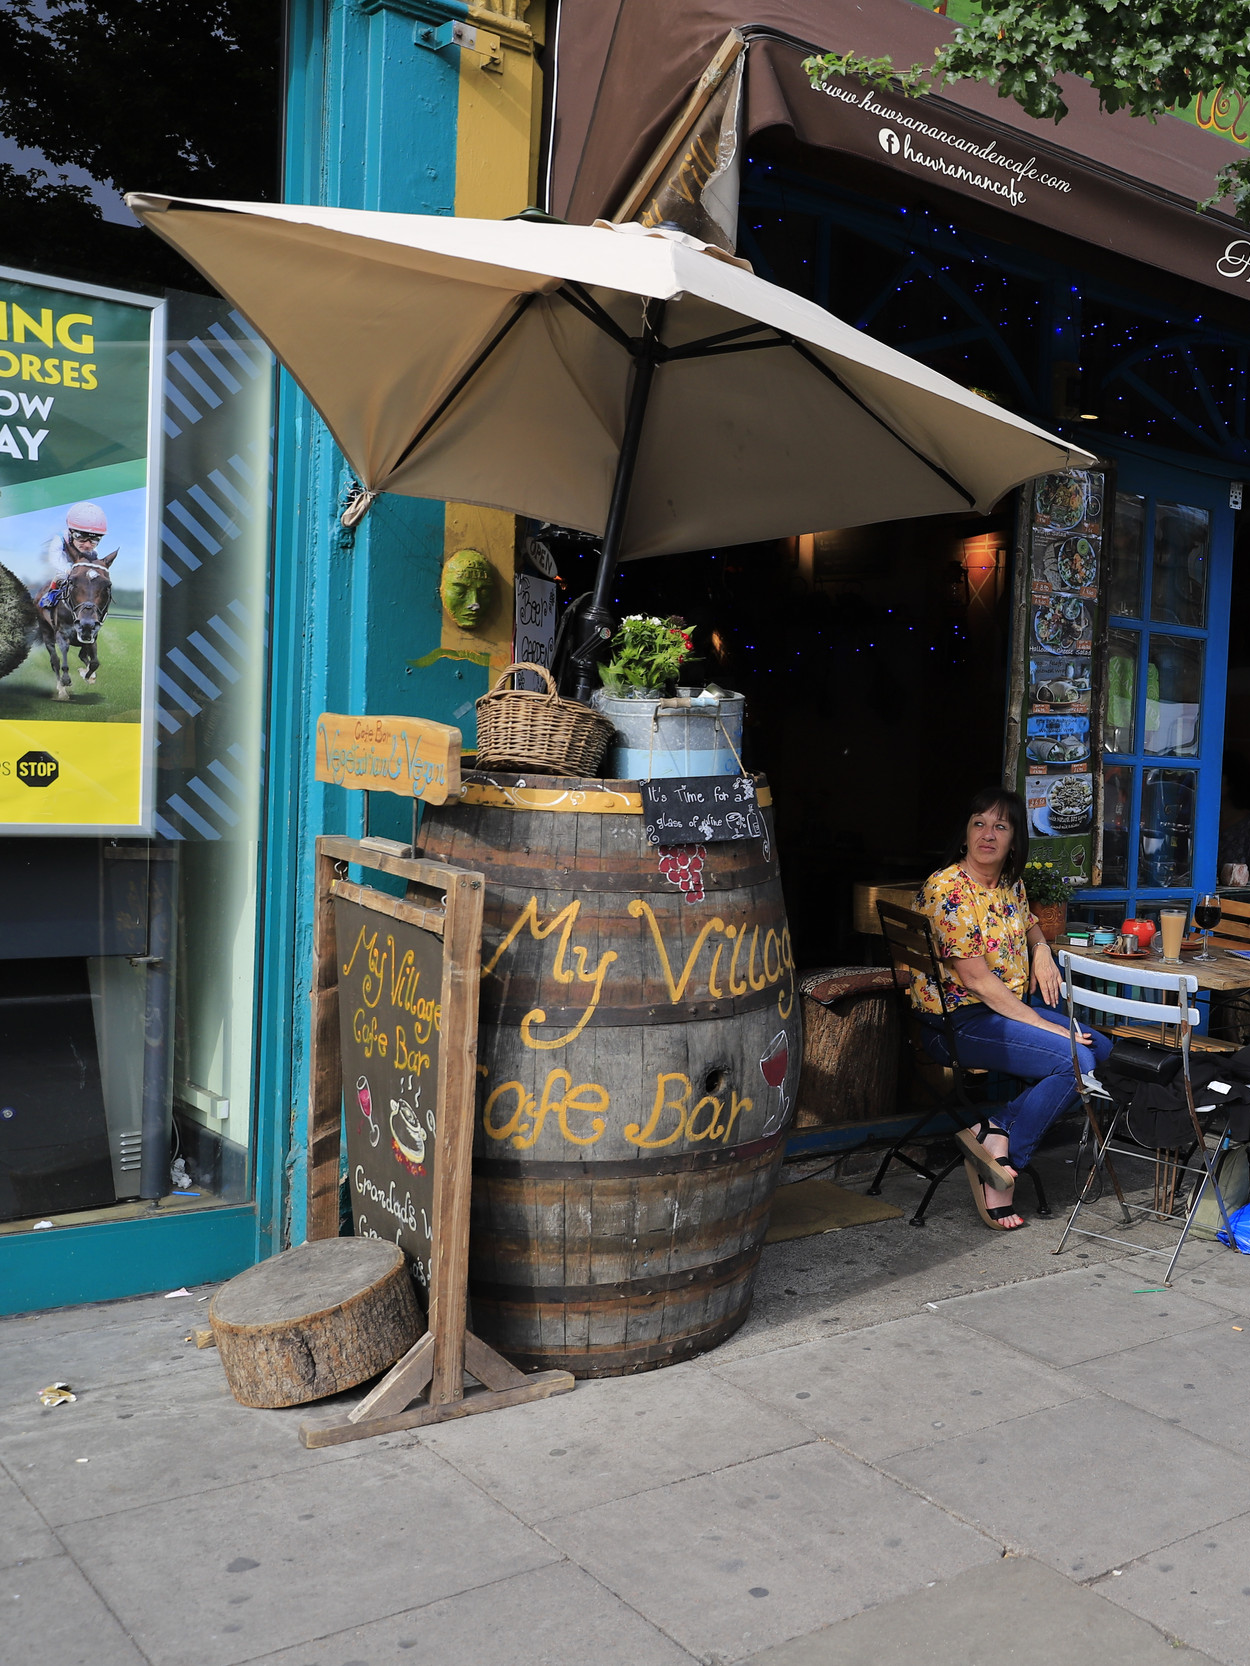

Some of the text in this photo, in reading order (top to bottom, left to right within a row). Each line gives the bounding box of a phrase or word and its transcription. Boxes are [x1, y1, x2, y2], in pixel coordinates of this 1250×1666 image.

[811, 80, 1072, 194] www.hawramancamdencafe.com
[903, 133, 1027, 207] hawramancafe
[0, 300, 95, 355] ING
[0, 350, 99, 392] ORSES
[0, 389, 55, 422] OW
[0, 423, 50, 462] AY
[529, 540, 553, 575] OPEN
[520, 590, 548, 628] Beer
[354, 719, 392, 744] Cafe Bar
[19, 761, 57, 777] STOP
[401, 729, 446, 797] Vegan
[647, 786, 668, 803] It's
[713, 785, 730, 803] for
[734, 794, 744, 803] a
[656, 812, 683, 830] glass
[688, 814, 700, 828] of
[342, 924, 443, 1045] My Village
[481, 894, 619, 1050] My
[353, 1007, 431, 1077] Cafe Bar
[478, 1064, 753, 1149] afe Bar
